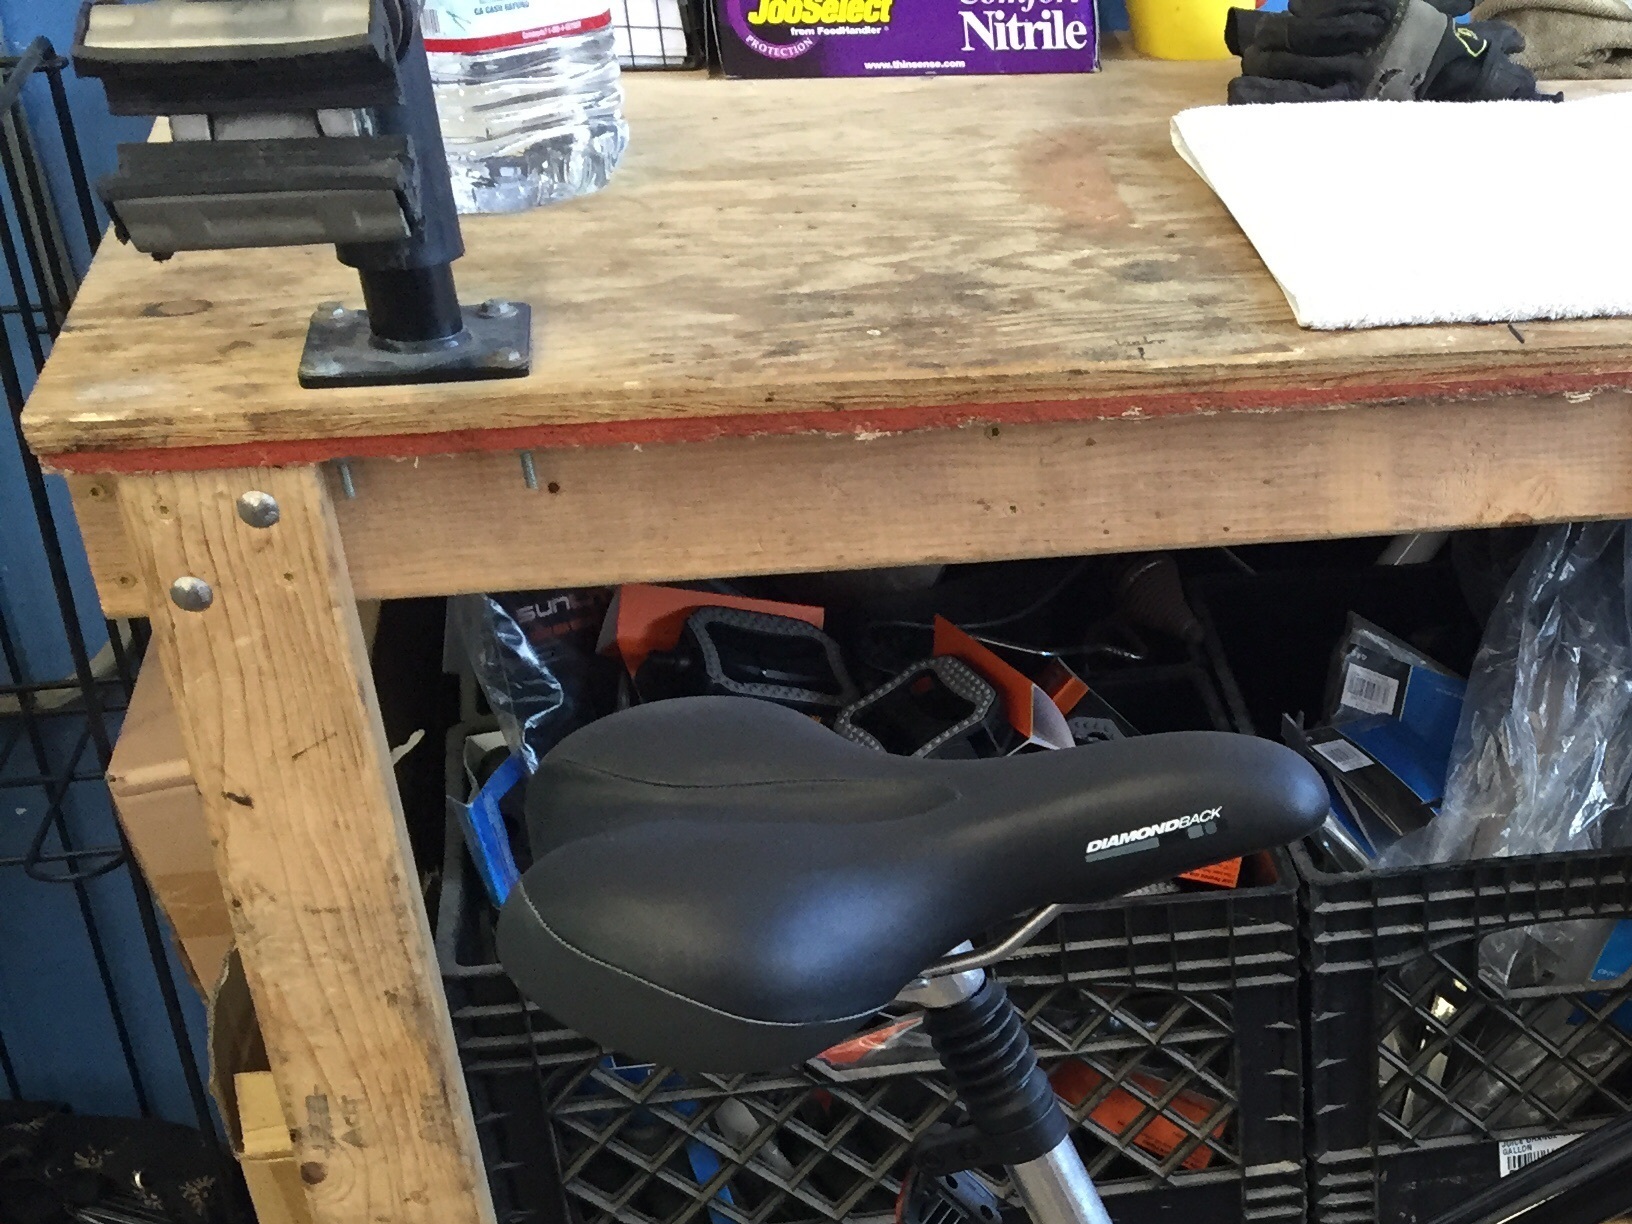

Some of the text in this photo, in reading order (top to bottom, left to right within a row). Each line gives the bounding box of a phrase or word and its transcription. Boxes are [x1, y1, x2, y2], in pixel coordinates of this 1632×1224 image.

[748, 0, 893, 24] JobSelect
[790, 27, 815, 36] from
[958, 9, 1088, 51] Nitrile
[745, 34, 814, 57] PROTECTION
[1085, 805, 1223, 854] DIAMONDBACK
[1502, 1143, 1533, 1156] GALLON
